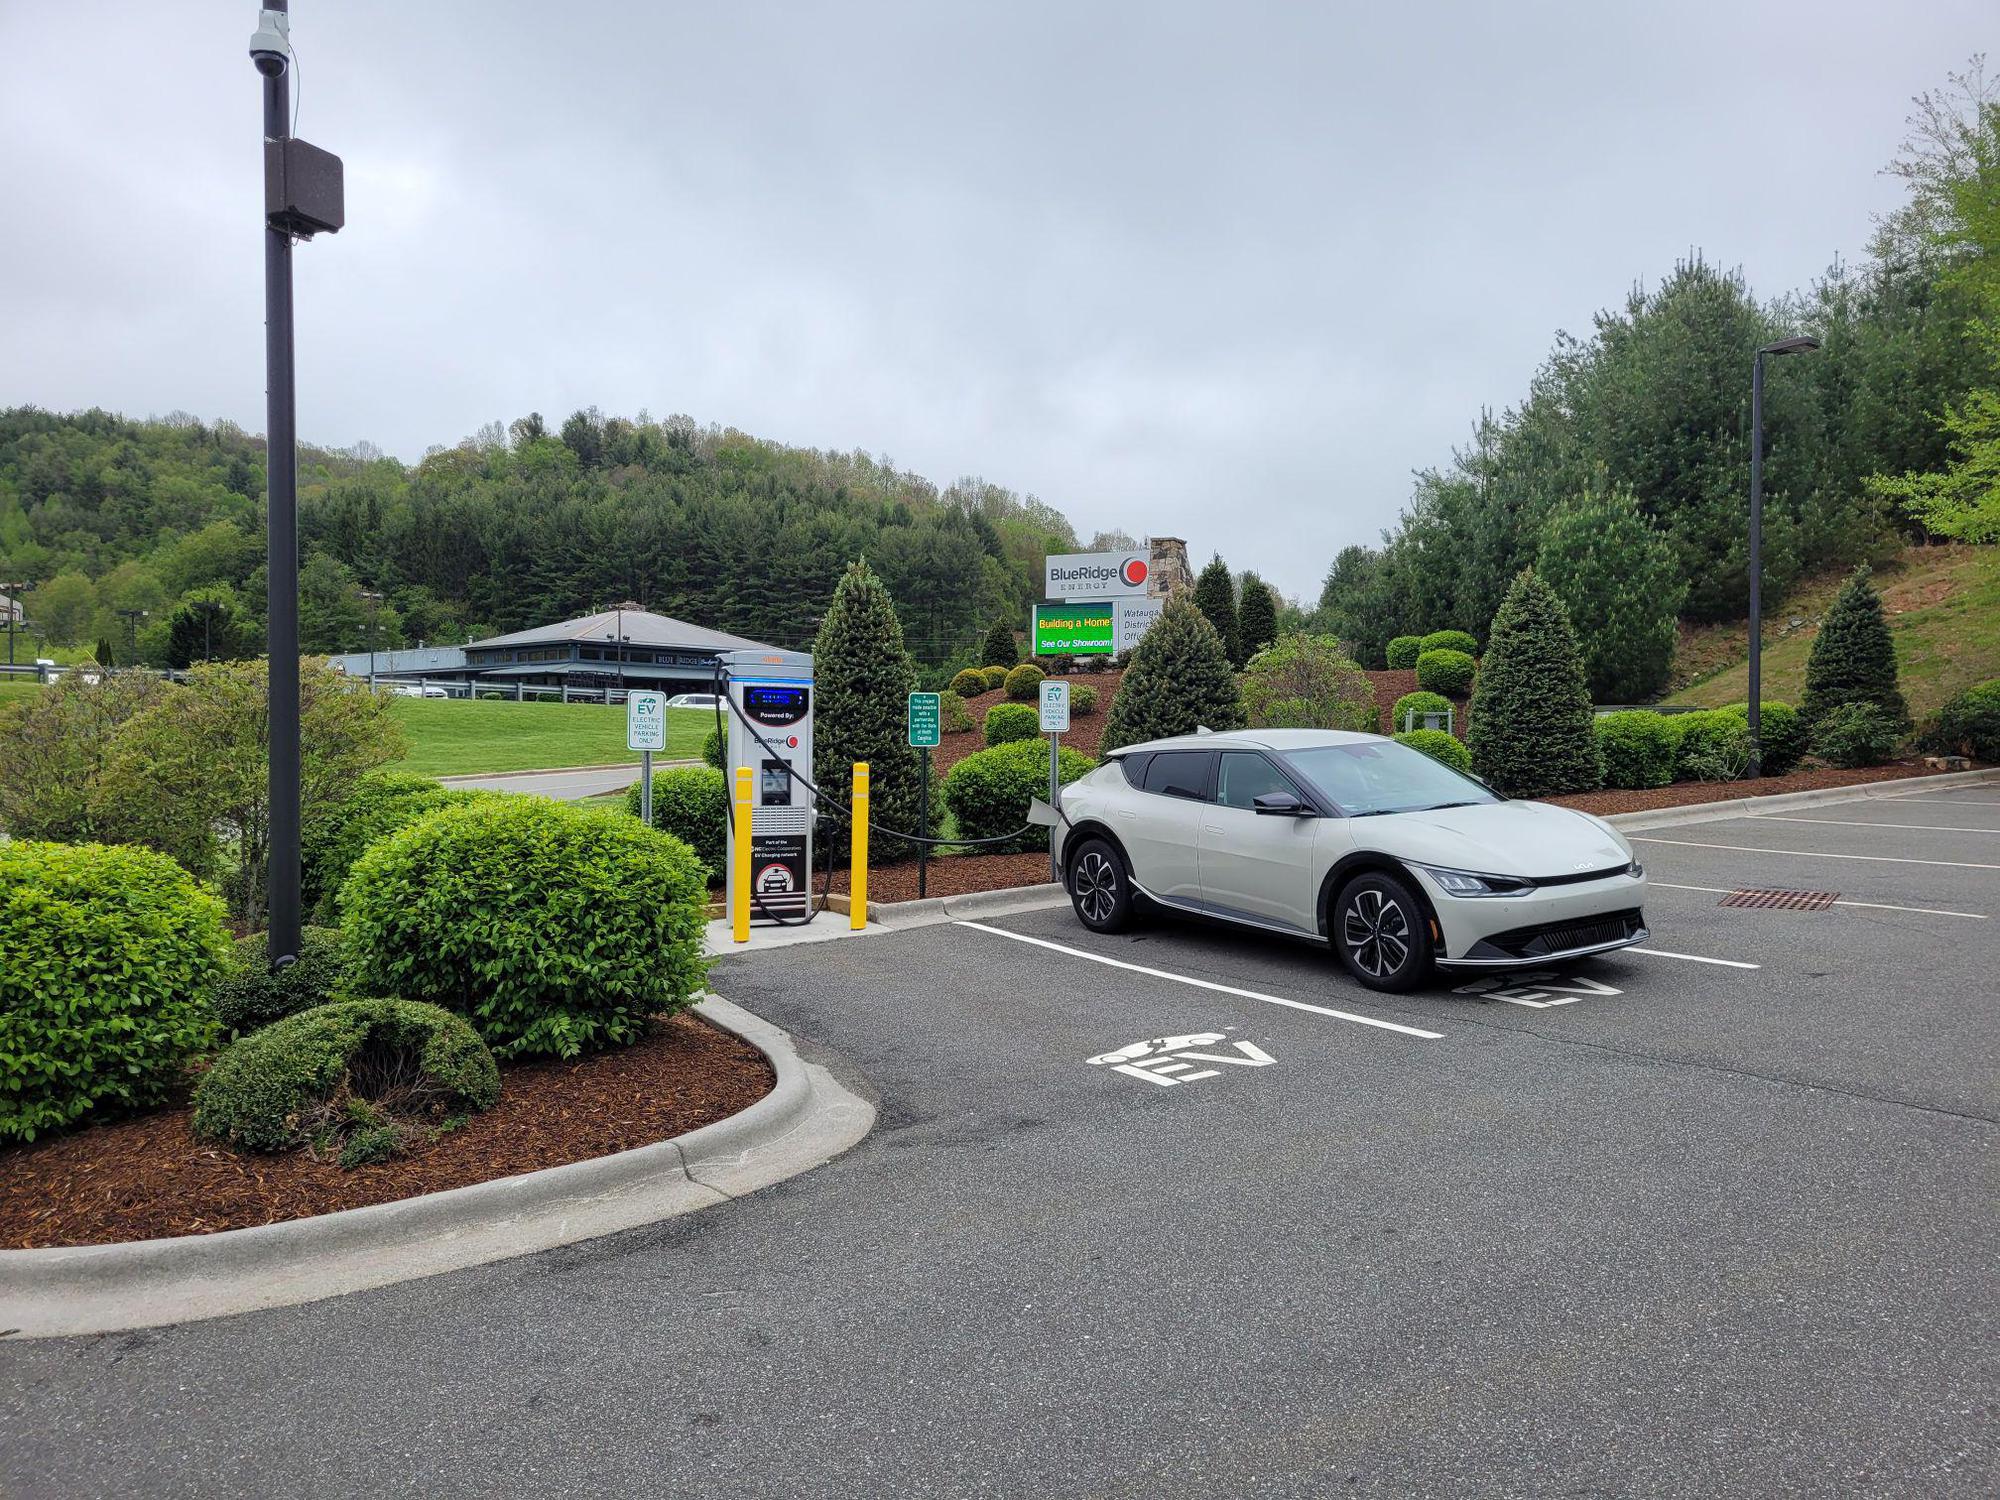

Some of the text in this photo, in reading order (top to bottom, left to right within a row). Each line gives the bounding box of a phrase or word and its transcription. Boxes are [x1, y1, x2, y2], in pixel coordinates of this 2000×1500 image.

[1050, 566, 1118, 581] BlueRidge
[1060, 582, 1108, 591] ENERGY
[1124, 609, 1158, 618] Watauga
[1039, 618, 1073, 629] Building
[1076, 619, 1081, 627] a
[1041, 638, 1112, 648] See Our Showroom!
[1047, 692, 1062, 701] EV
[638, 704, 656, 715] EV
[1479, 976, 1625, 1009] EV
[1110, 1040, 1278, 1087] EV
